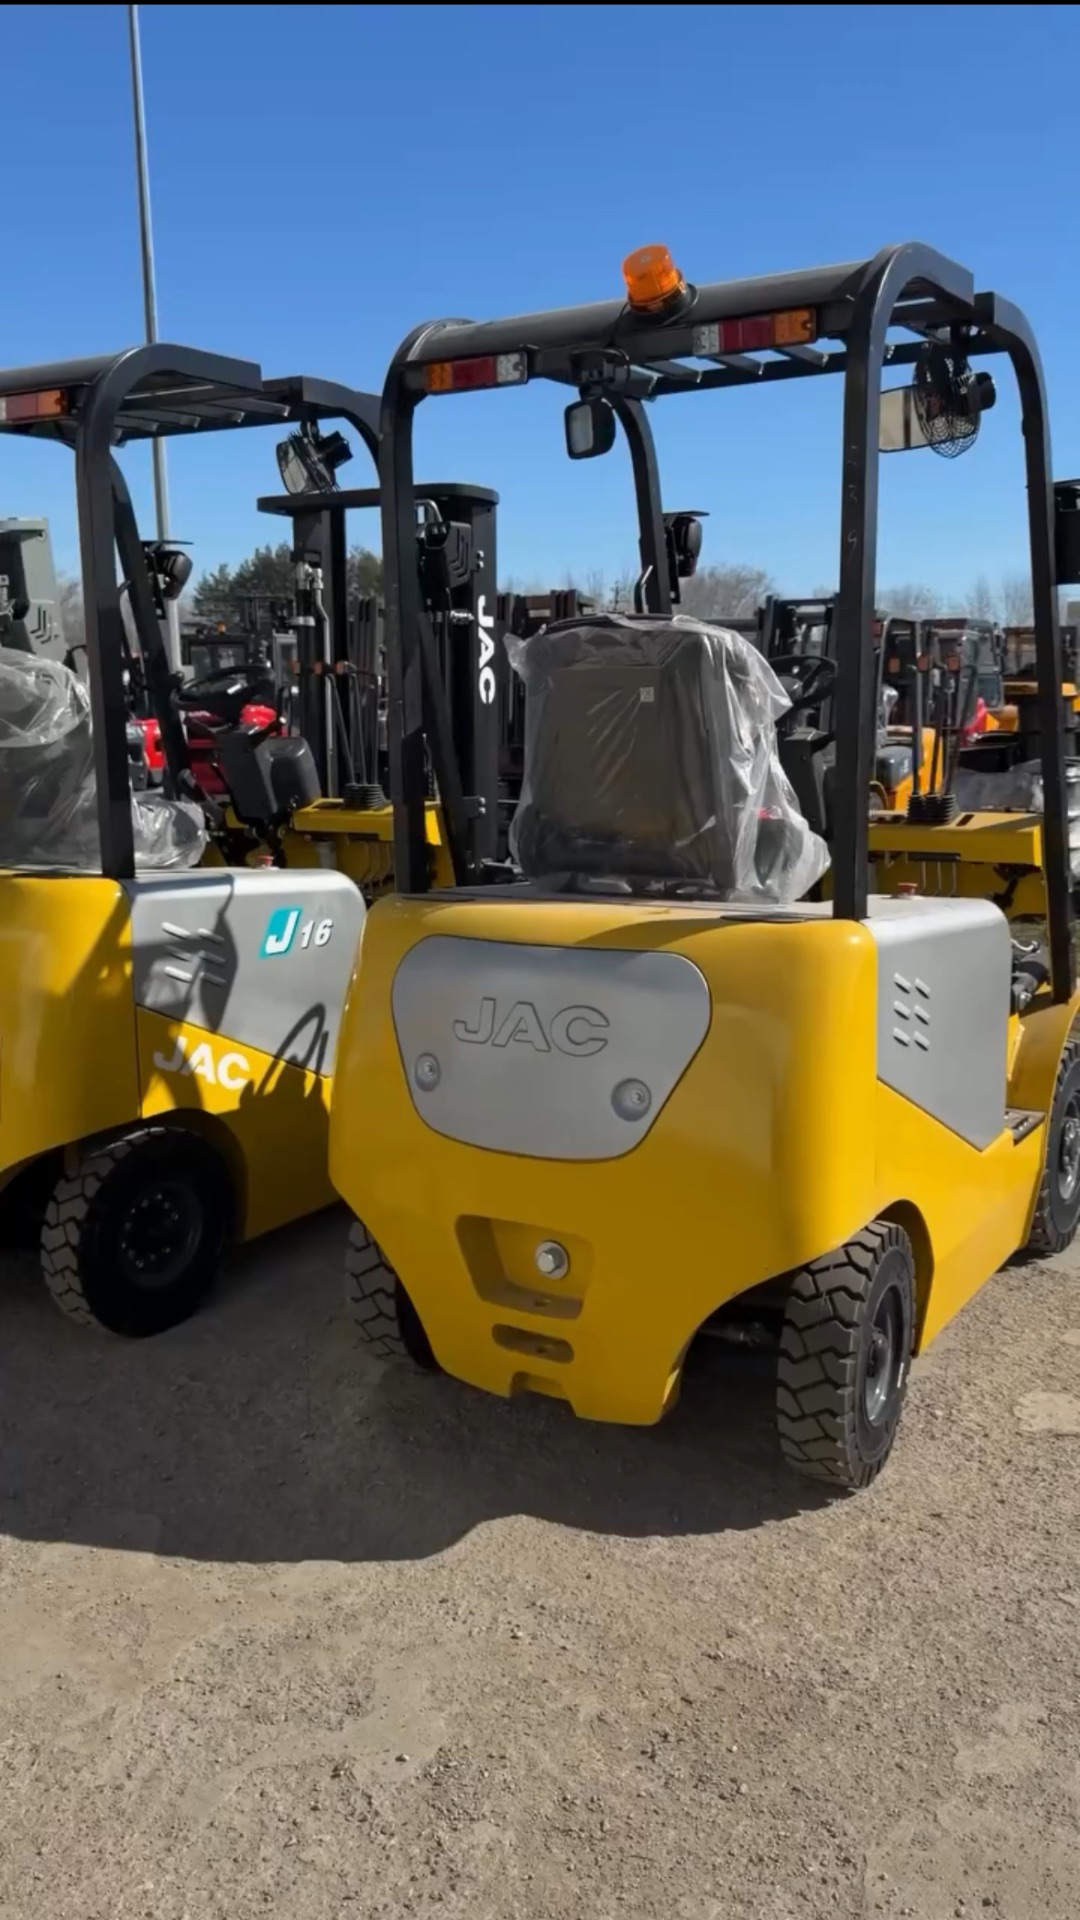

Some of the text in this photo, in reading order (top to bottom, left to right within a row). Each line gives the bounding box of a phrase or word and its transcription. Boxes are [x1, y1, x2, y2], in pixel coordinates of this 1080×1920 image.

[478, 594, 496, 704] JAC
[453, 996, 610, 1058] JAC
[153, 1035, 251, 1091] JAC
